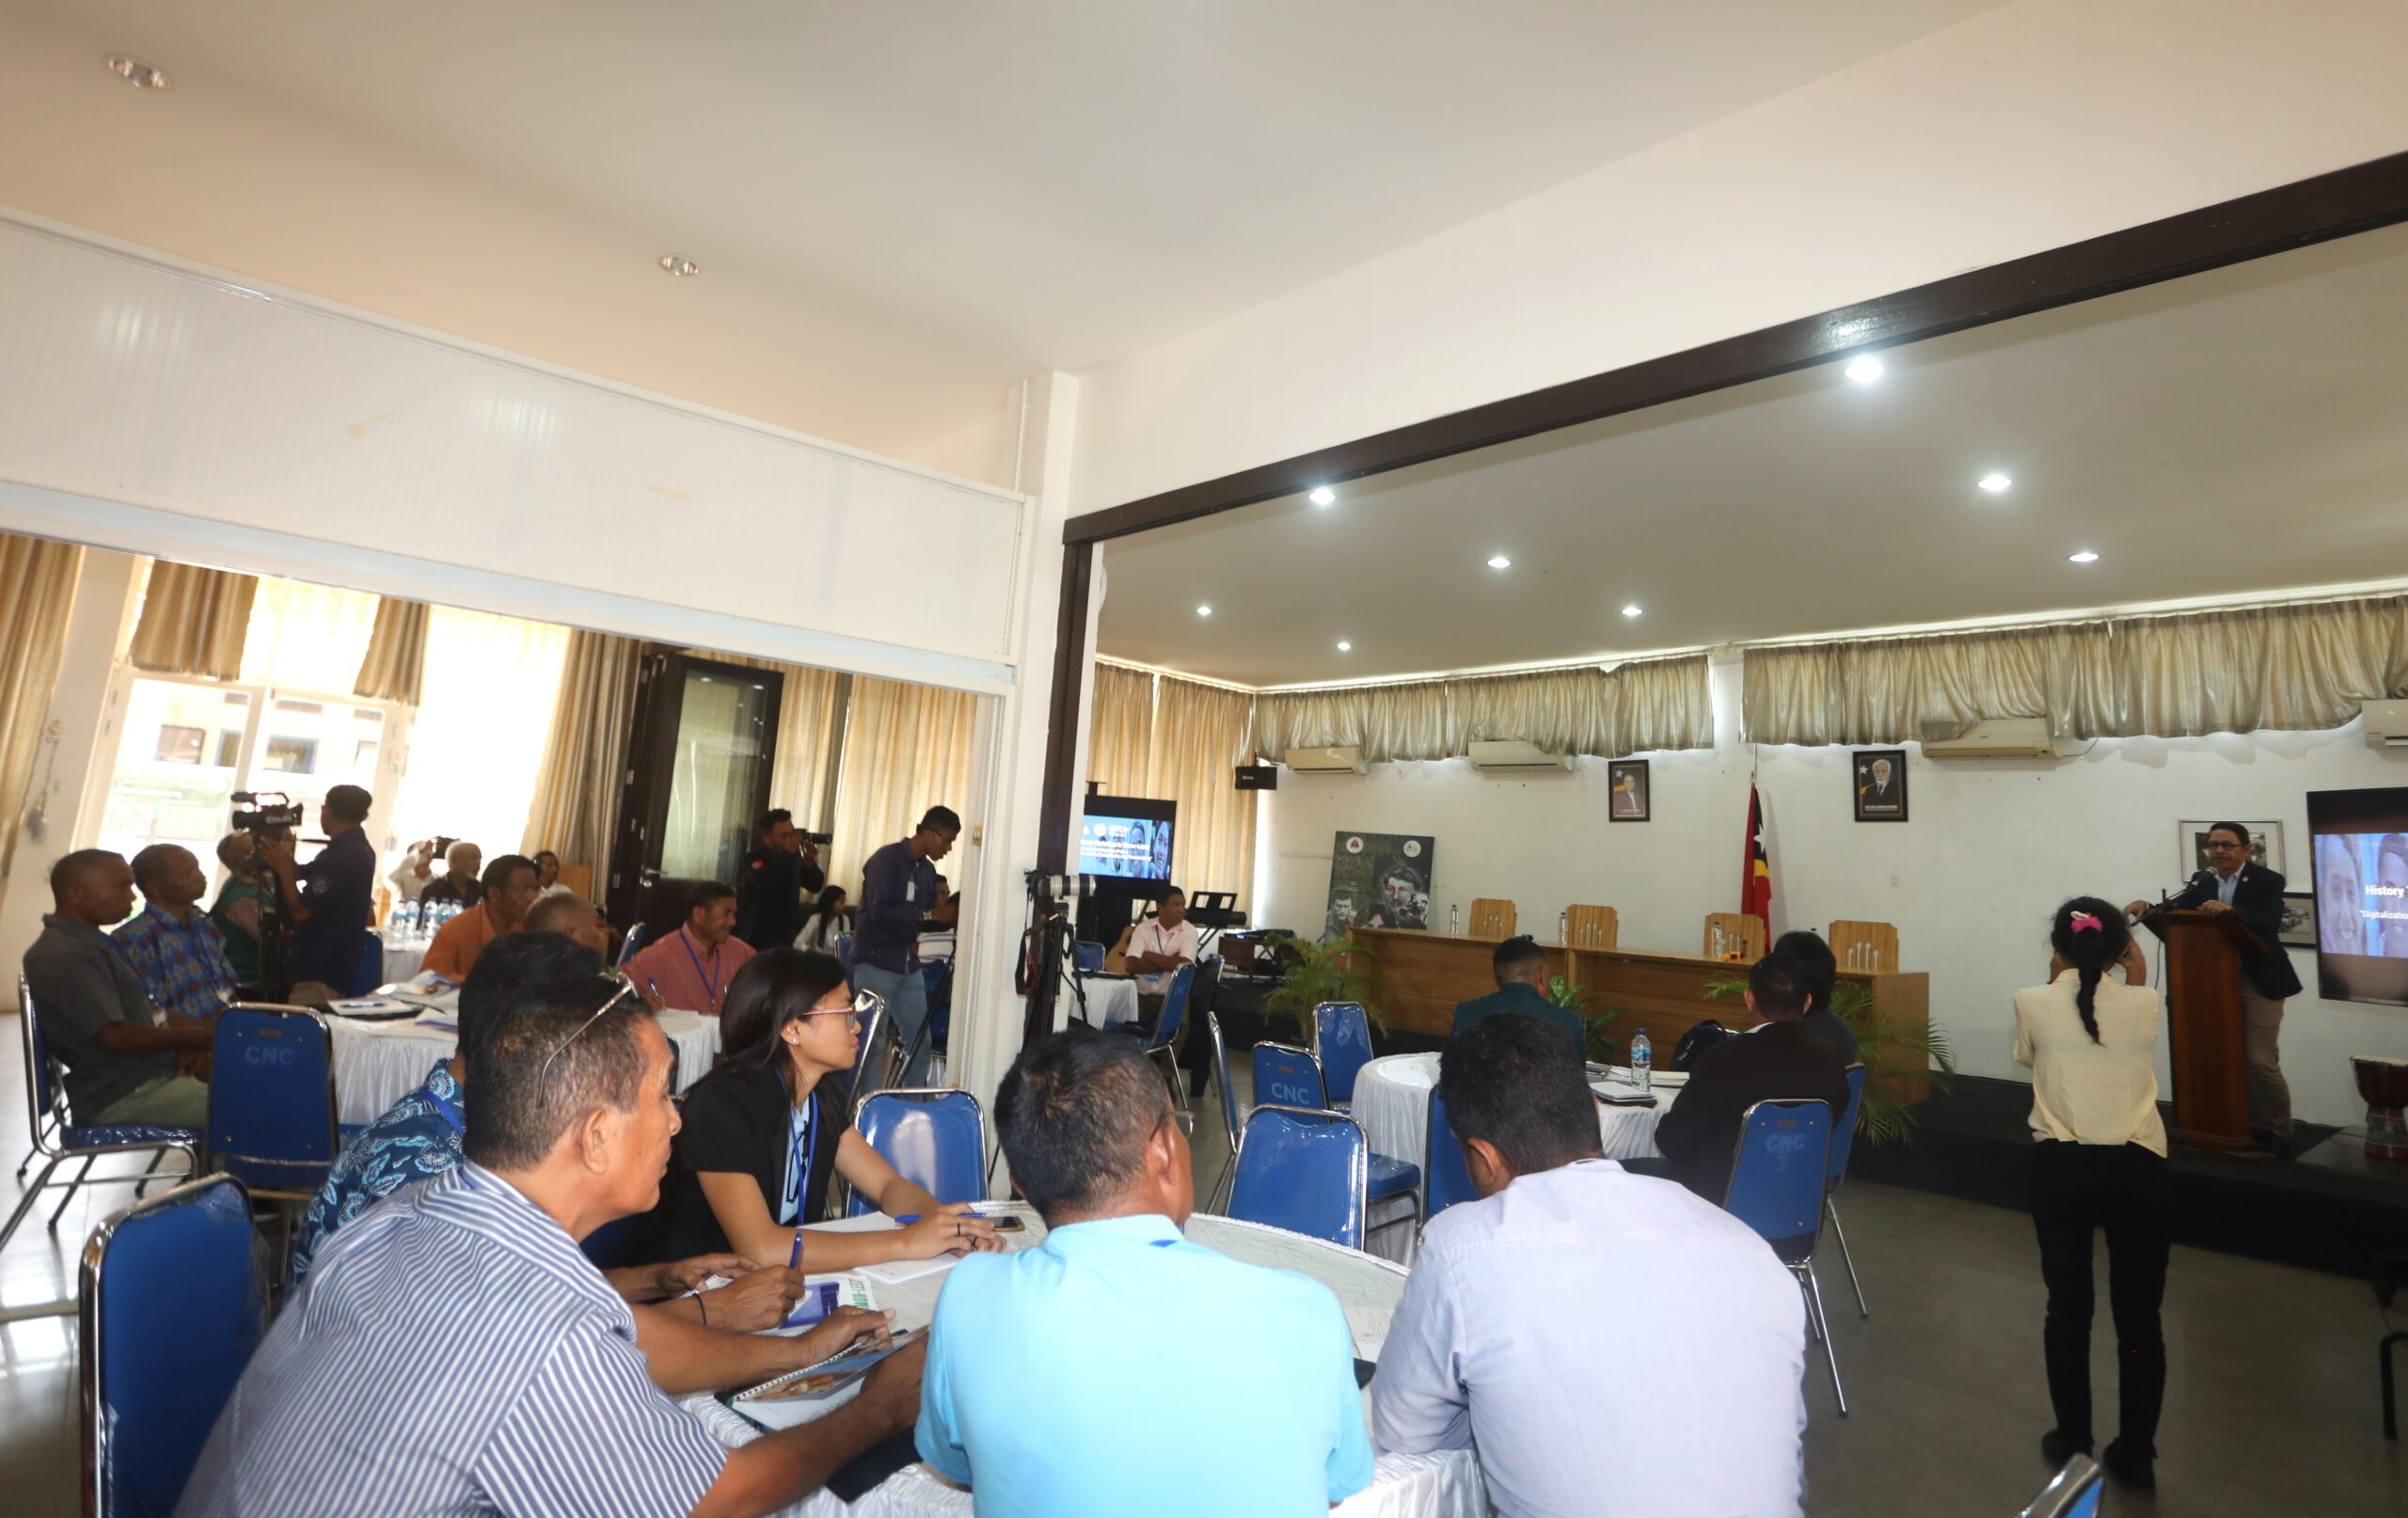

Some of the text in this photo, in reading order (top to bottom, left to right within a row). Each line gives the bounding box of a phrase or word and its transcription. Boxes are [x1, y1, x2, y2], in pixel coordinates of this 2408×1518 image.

[2365, 884, 2405, 899] History
[2359, 909, 2408, 920] "Digitalizatio
[245, 1045, 293, 1066] CNC
[1271, 1082, 1309, 1105] CNC
[1766, 1133, 1806, 1152] CNC
[848, 1277, 869, 1309] MOR-LEST
